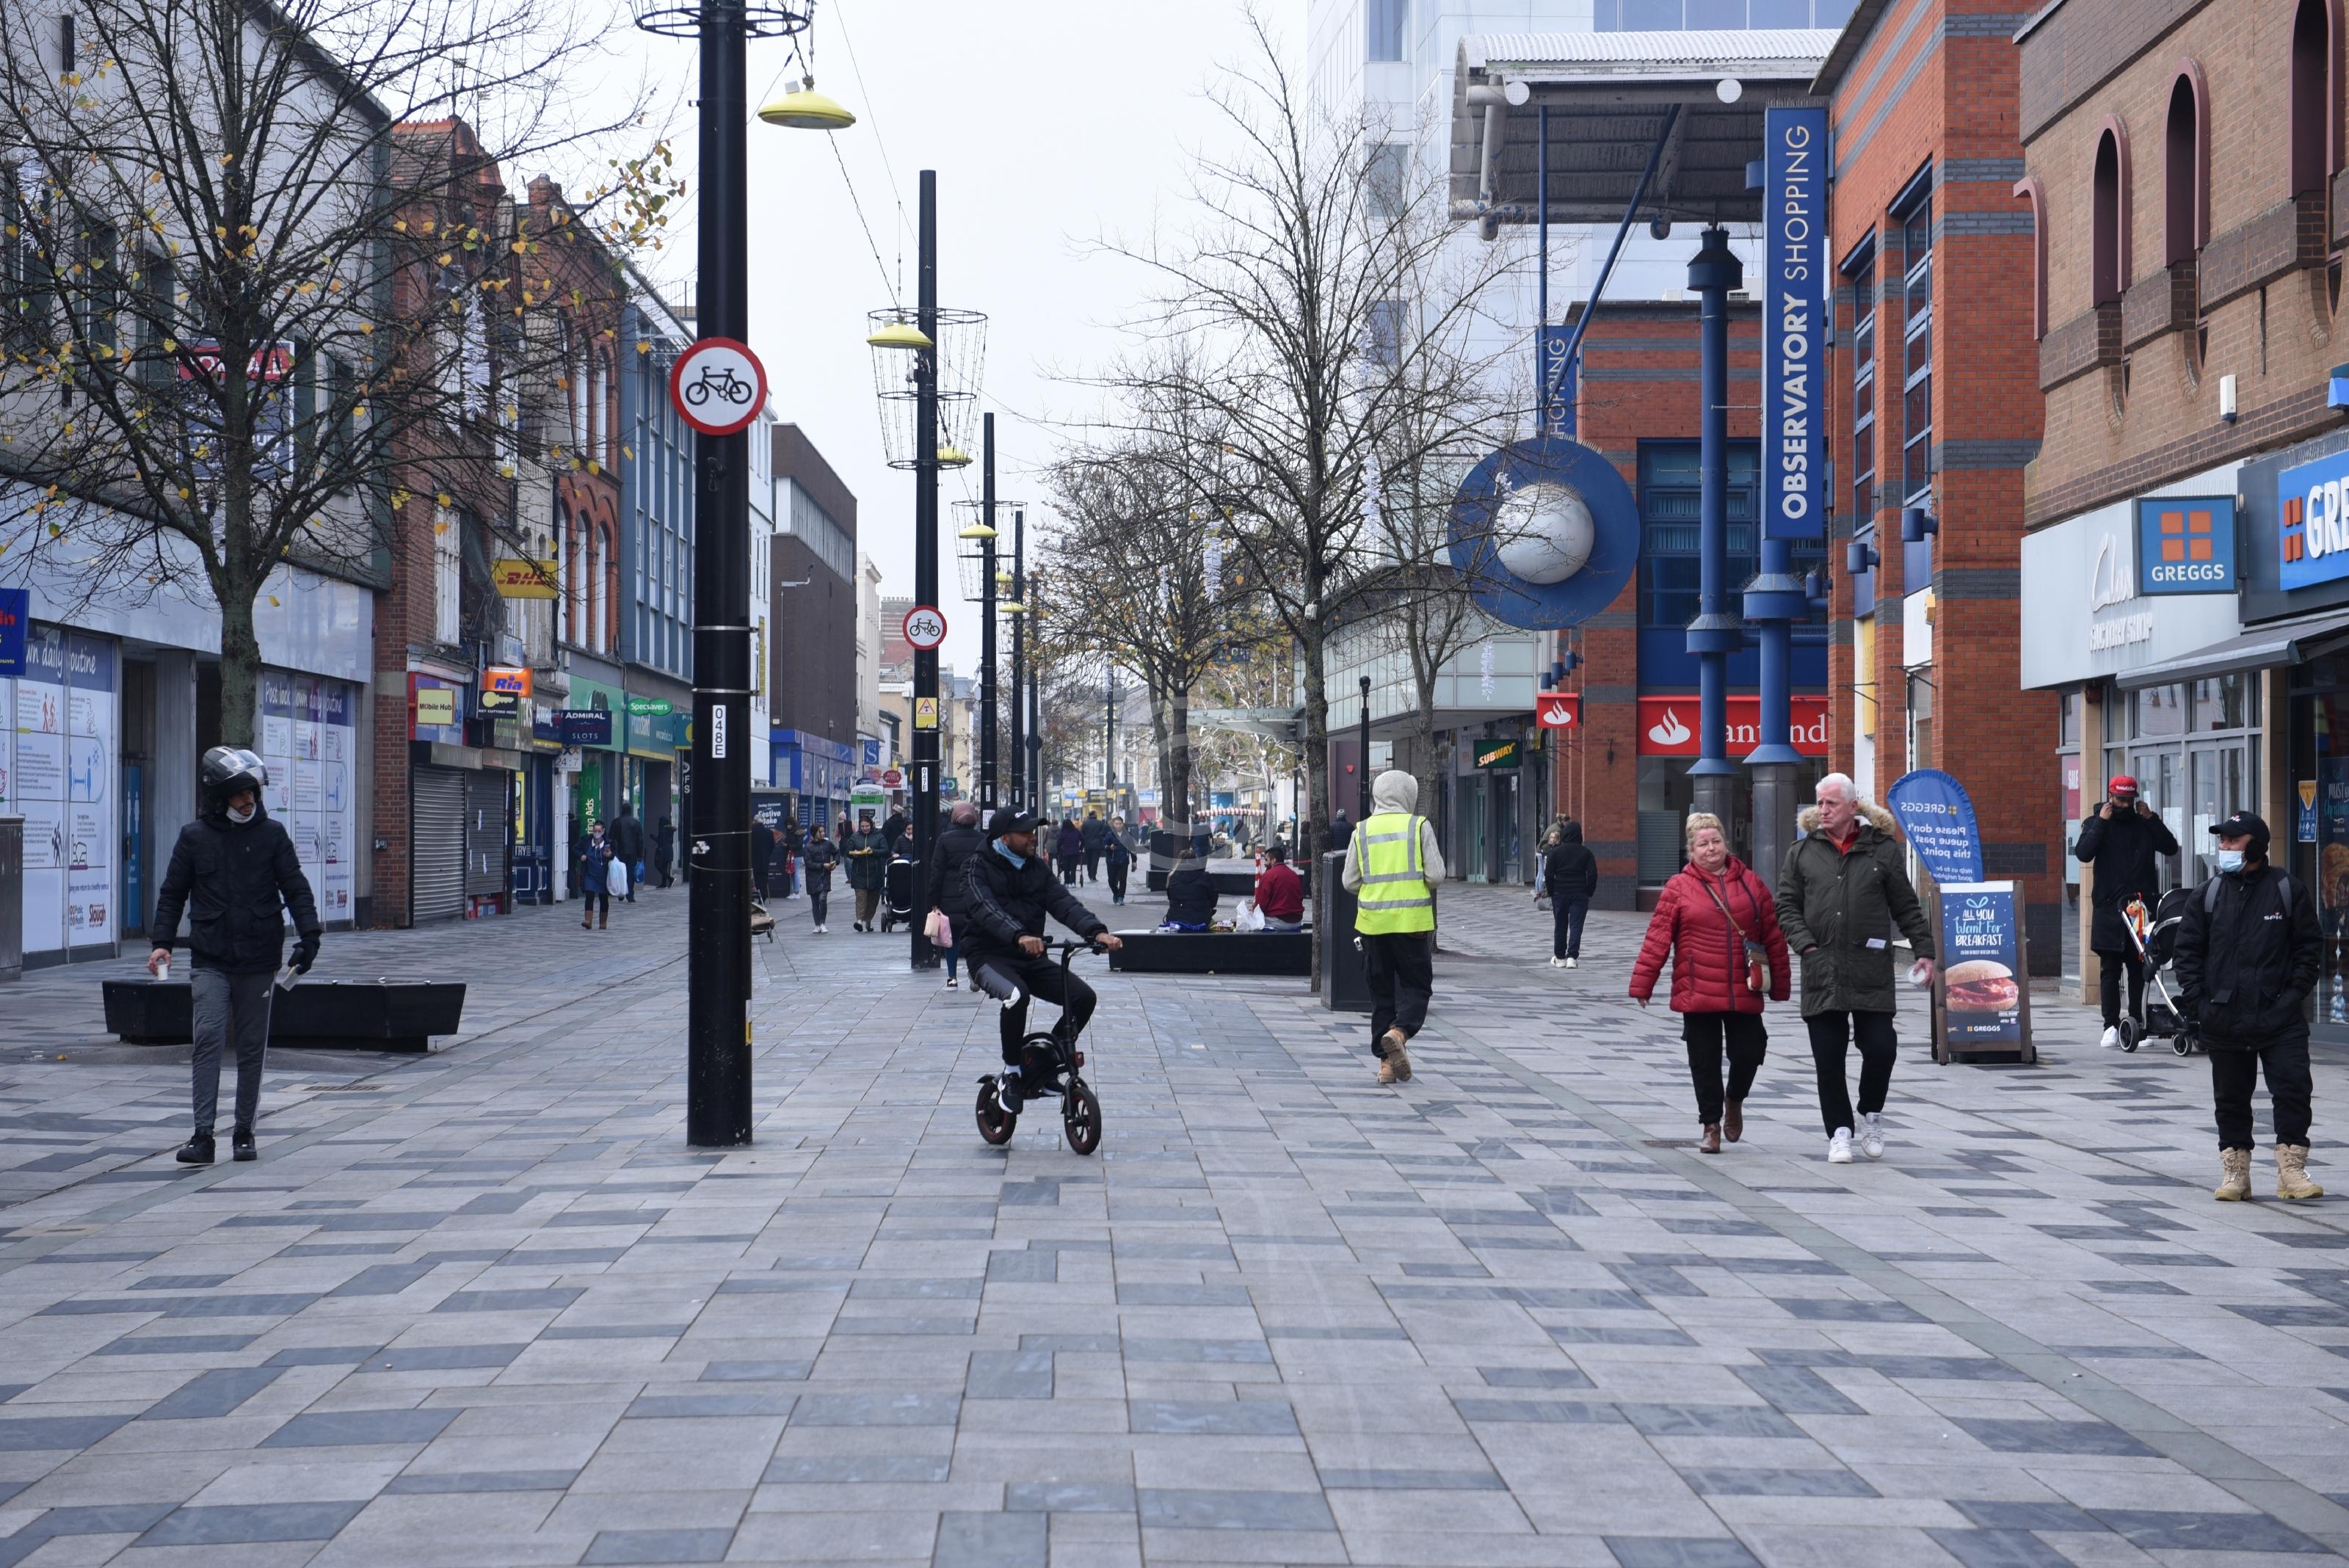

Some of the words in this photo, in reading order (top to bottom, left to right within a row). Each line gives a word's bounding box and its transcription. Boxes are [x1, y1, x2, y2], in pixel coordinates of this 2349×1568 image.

[1785, 125, 1810, 281] SHOPPING
[1783, 293, 1809, 520] OBSERVATORY
[2152, 564, 2225, 581] GREGGS
[2091, 618, 2127, 651] FACTORY
[2127, 612, 2153, 645] SHOP
[42, 637, 63, 679] daily
[265, 681, 278, 705] Post
[494, 675, 523, 691] Ria
[631, 703, 668, 711] Specsavers
[715, 708, 724, 755] 048E
[1478, 742, 1516, 767] SUBWAY
[2068, 769, 2079, 790] SALE
[2328, 782, 2345, 799] MUST
[586, 799, 594, 816] Aids
[89, 904, 106, 926] Slough
[1954, 917, 1983, 934] Want
[1986, 921, 2003, 933] For
[1963, 909, 1975, 919] ALL
[1975, 909, 1994, 921] YOU
[1956, 933, 2003, 946] BREAKFAST
